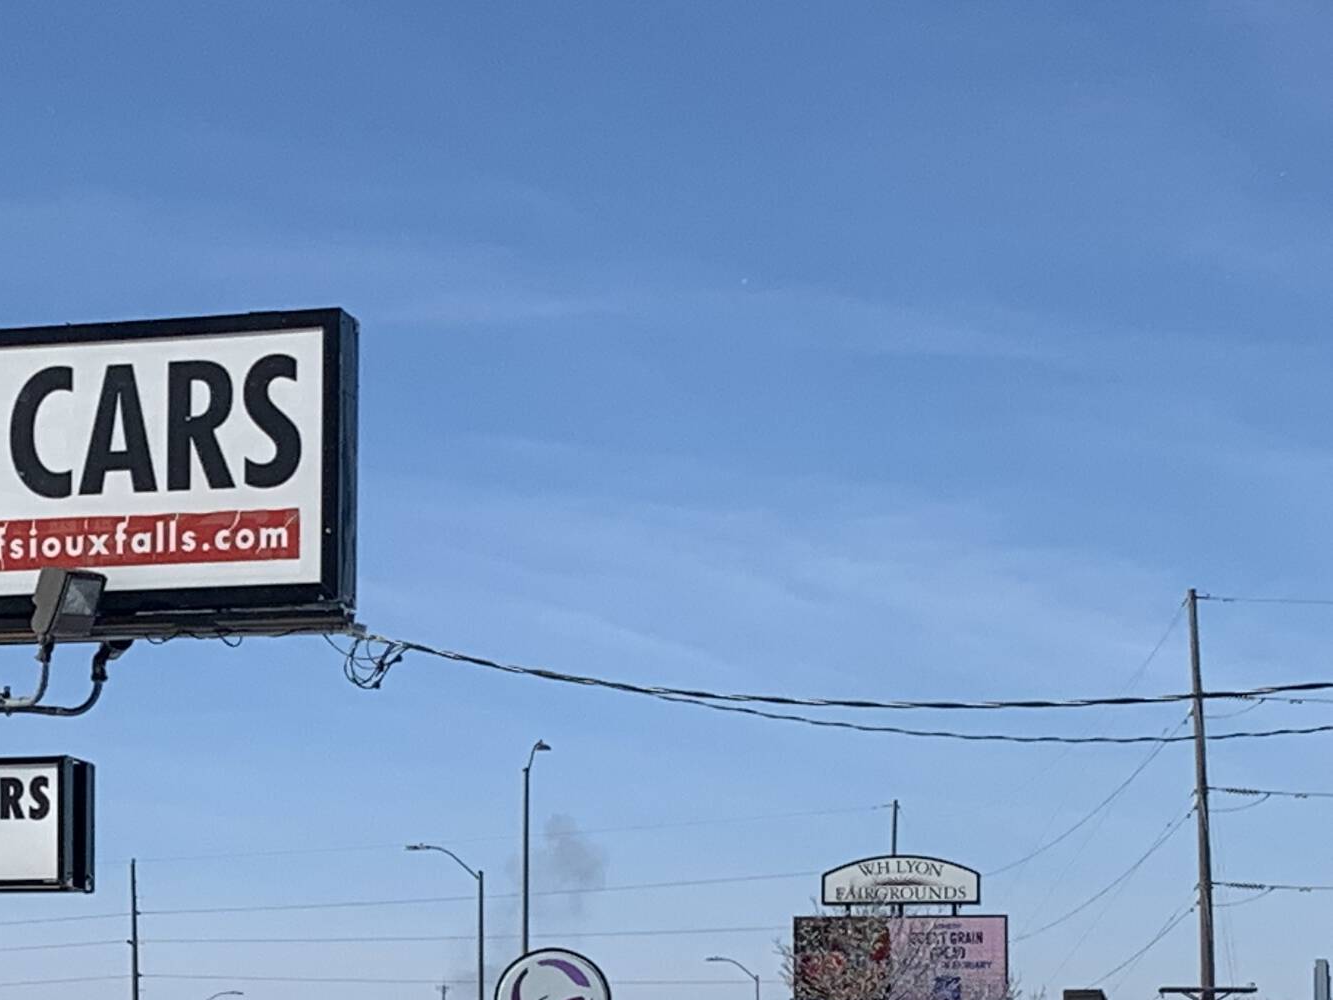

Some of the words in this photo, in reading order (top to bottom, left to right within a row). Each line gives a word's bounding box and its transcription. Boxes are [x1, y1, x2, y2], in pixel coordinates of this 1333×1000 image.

[9, 353, 302, 499] CARS
[896, 860, 944, 877] LYON
[835, 885, 966, 901] FAIRGROUNDS
